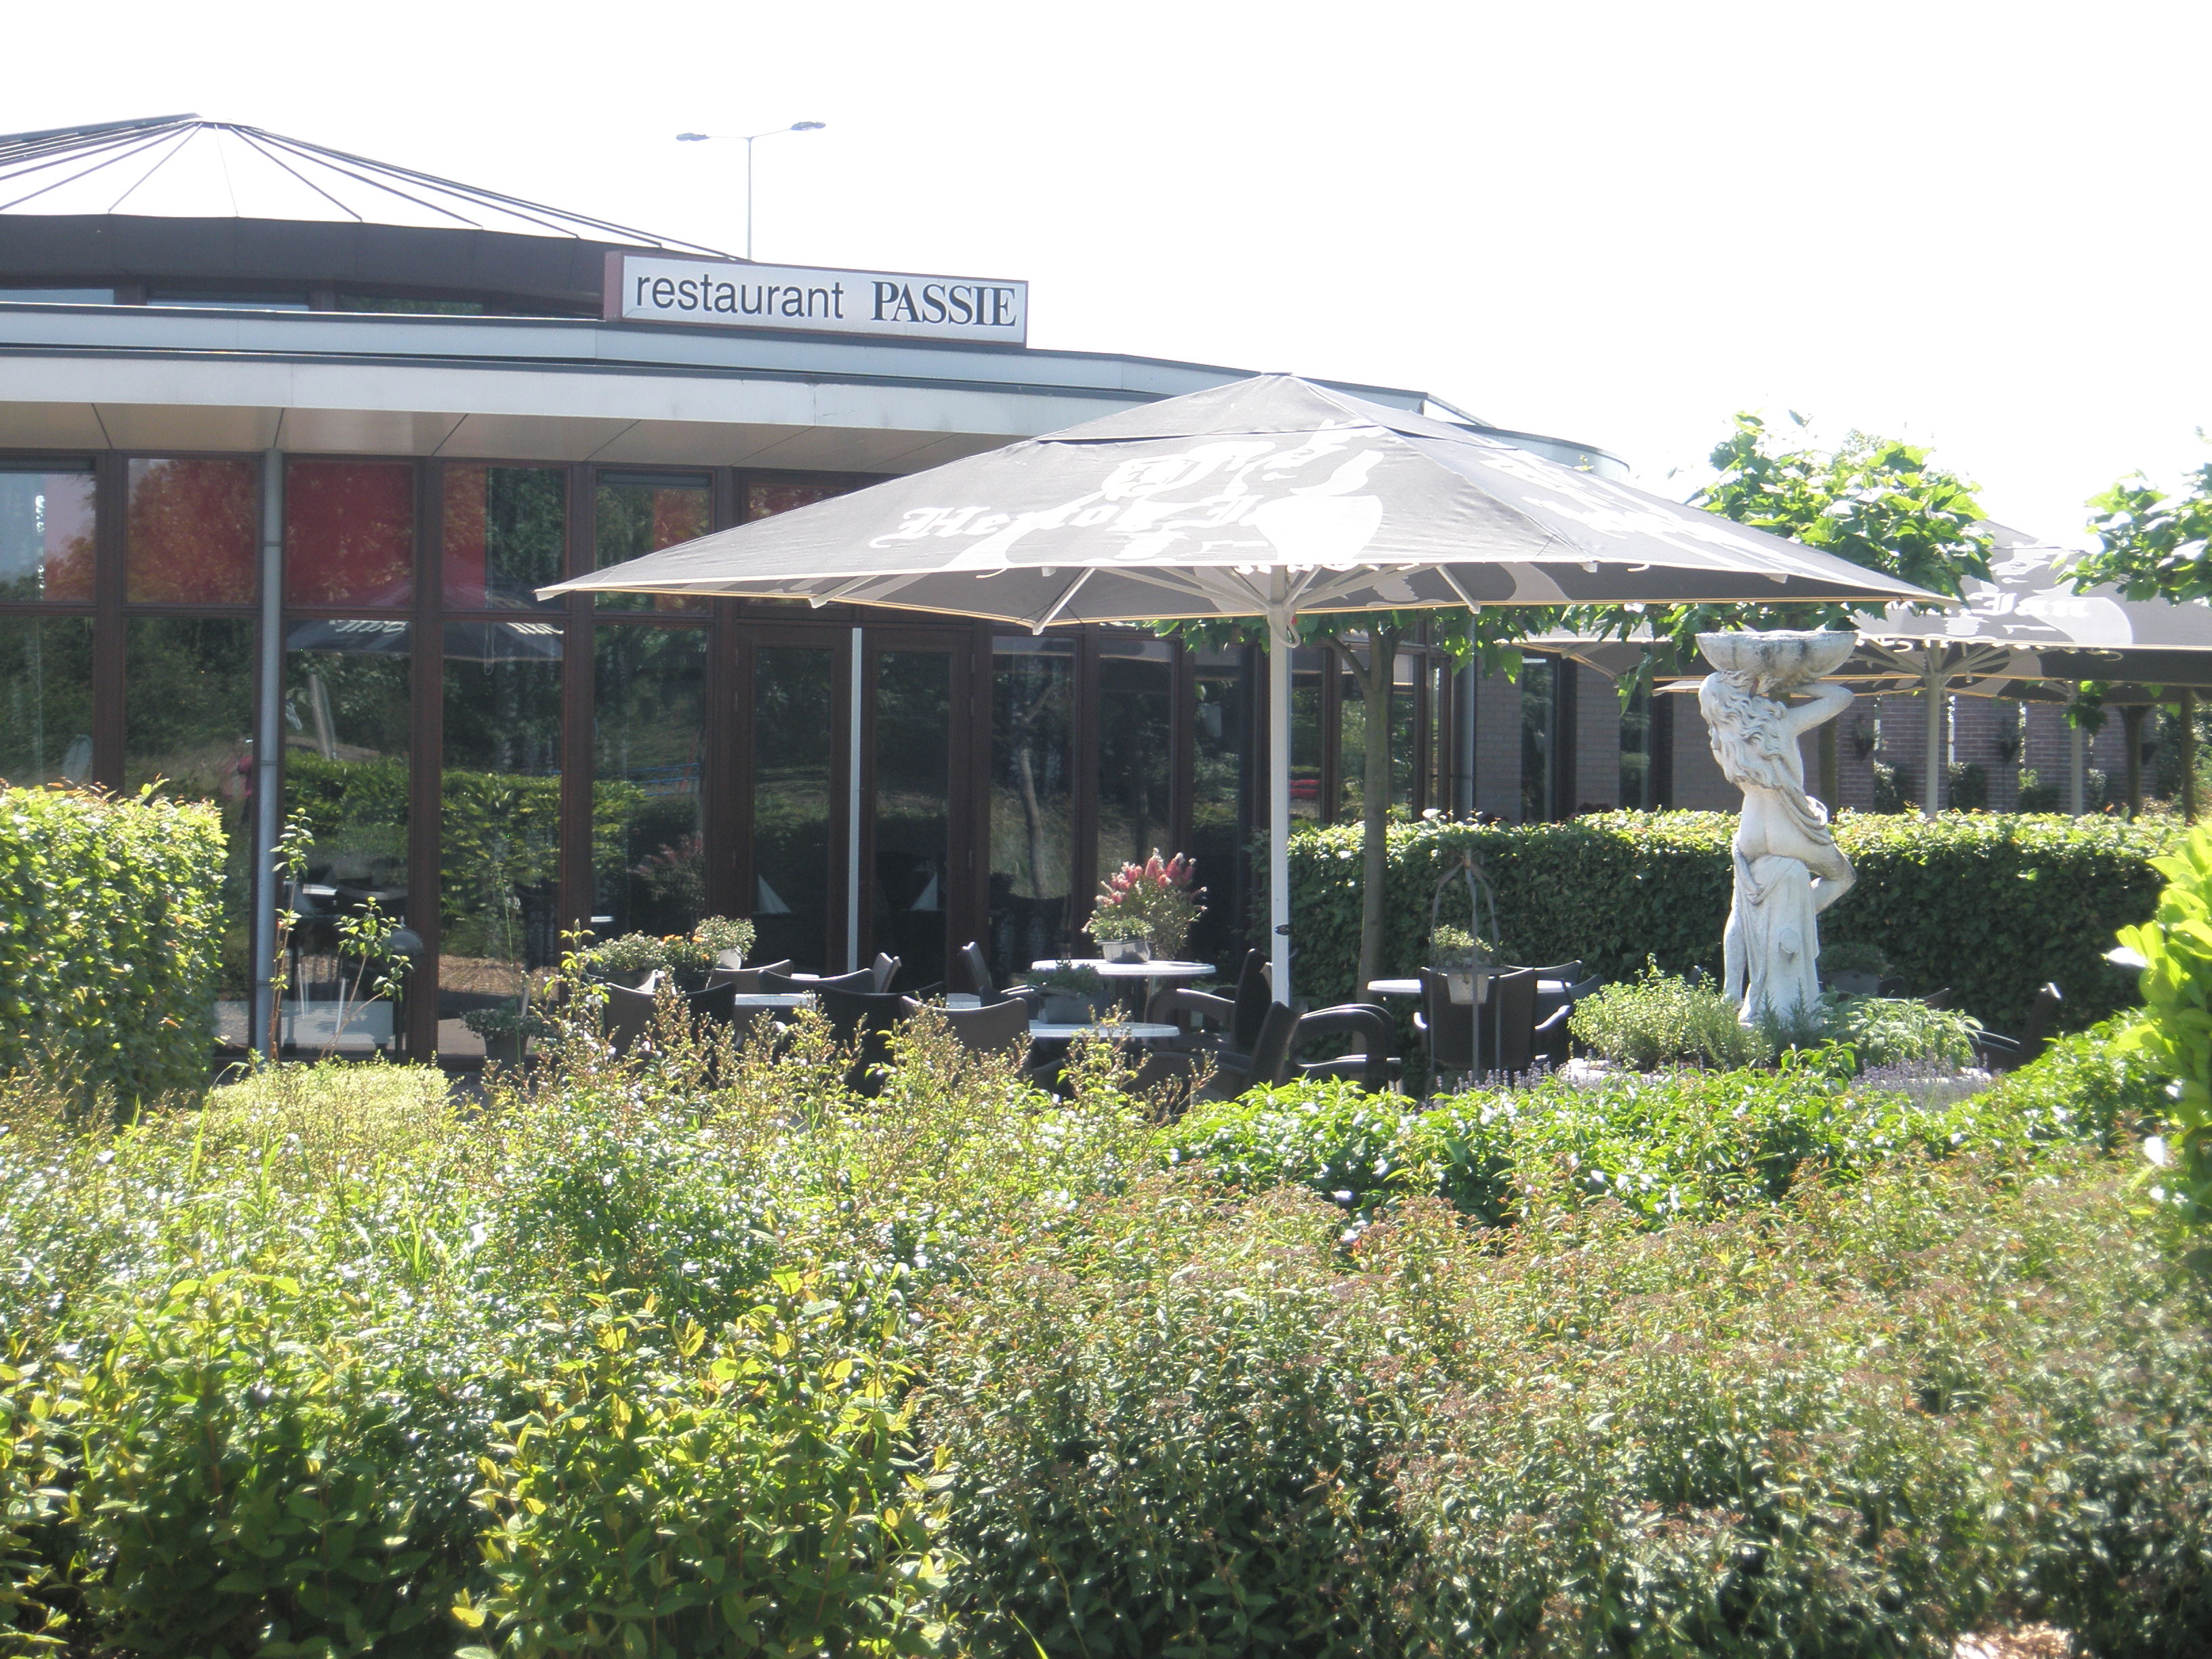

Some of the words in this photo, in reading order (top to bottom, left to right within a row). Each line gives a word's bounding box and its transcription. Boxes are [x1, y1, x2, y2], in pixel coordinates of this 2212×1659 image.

[636, 274, 844, 319] restaurant
[870, 280, 1017, 327] PASSIE
[1965, 592, 2090, 617] Jan
